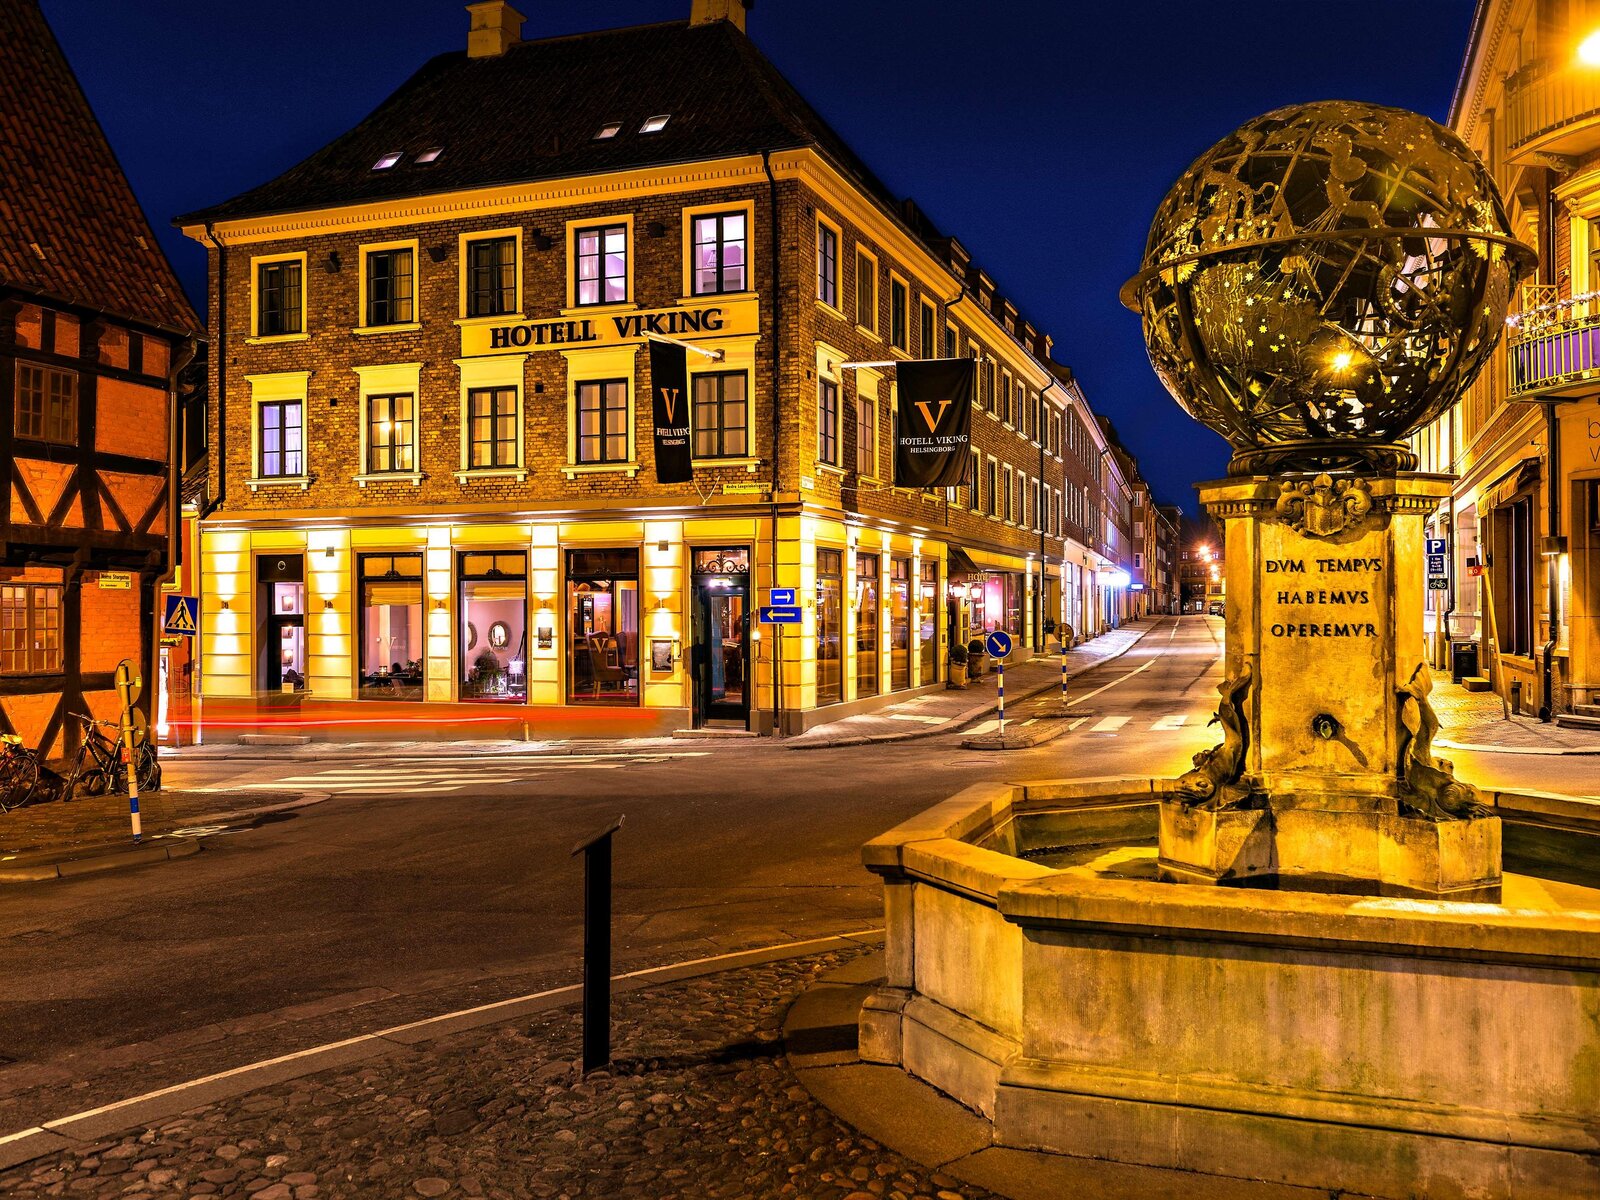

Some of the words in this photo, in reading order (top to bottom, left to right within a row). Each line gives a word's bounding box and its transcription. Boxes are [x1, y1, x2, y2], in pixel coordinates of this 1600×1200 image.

[490, 320, 597, 348] HOTELL
[612, 308, 724, 338] VIKING
[660, 387, 679, 424] V
[914, 400, 952, 433] V
[900, 437, 934, 446] HOTELL
[935, 434, 968, 445] VIKING
[910, 445, 956, 454] HELSINGBORG
[1431, 541, 1442, 553] P
[1266, 560, 1306, 573] DVM
[1316, 559, 1382, 572] TEMPVS
[1277, 591, 1370, 605] HABEMVS
[1271, 624, 1380, 637] OPEREMVR
